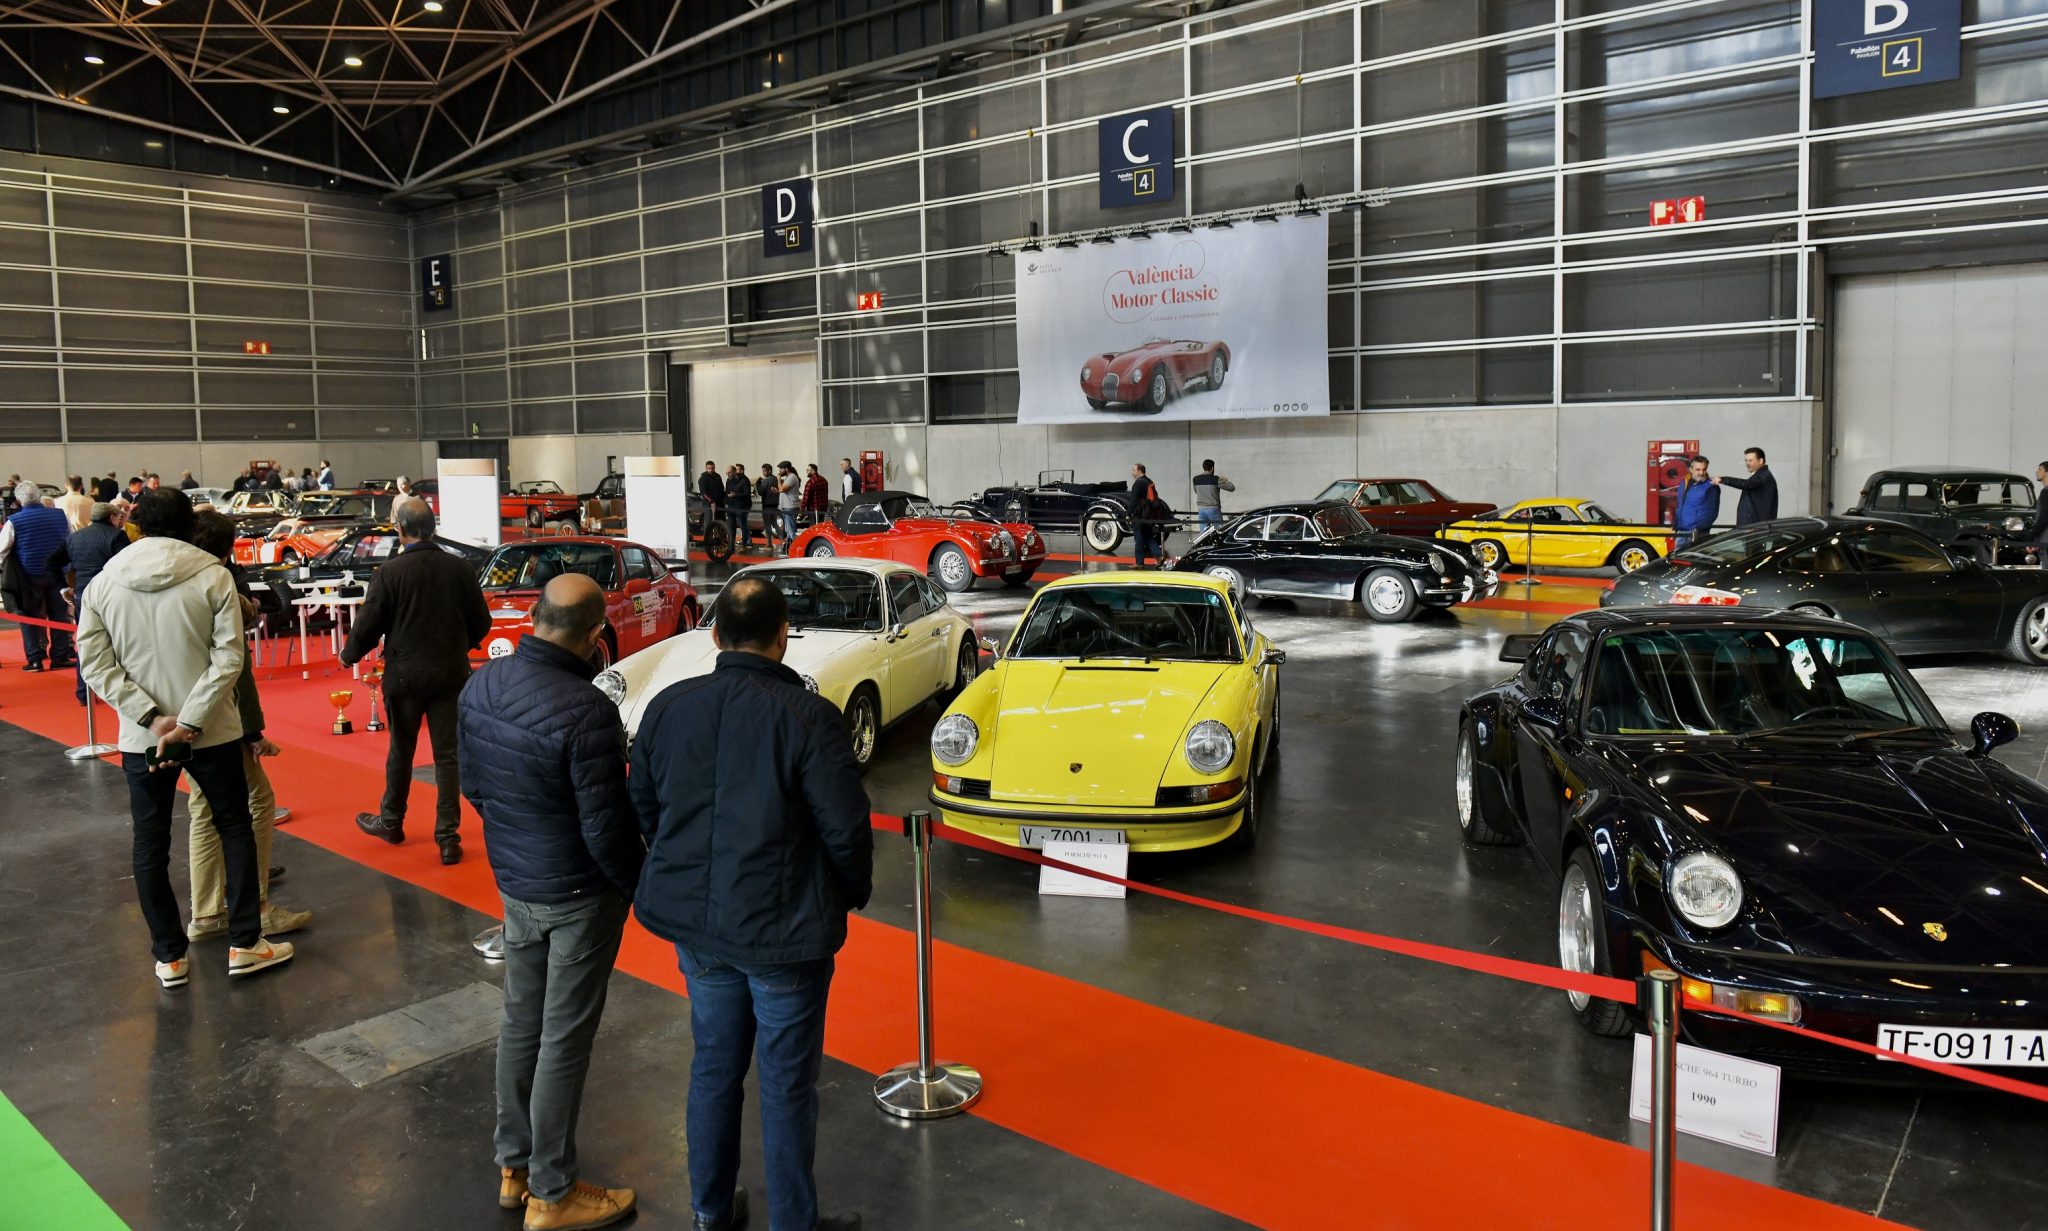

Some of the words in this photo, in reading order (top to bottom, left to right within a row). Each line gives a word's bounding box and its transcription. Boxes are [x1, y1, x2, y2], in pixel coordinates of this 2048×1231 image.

[1892, 45, 1911, 68] 4
[1122, 119, 1149, 164] C
[1139, 173, 1149, 190] 4
[776, 187, 796, 224] D
[789, 230, 796, 243] 4
[431, 260, 440, 287] E
[1127, 264, 1195, 285] València
[1111, 293, 1158, 310] Motor
[1161, 284, 1218, 304] Classic
[1022, 828, 1032, 845] V
[1051, 829, 1090, 841] 7001
[1883, 1029, 2045, 1061] TF-0911-A
[1703, 1069, 1719, 1079] 964
[1721, 1072, 1758, 1089] TURBO
[1691, 1091, 1717, 1107] 1990
